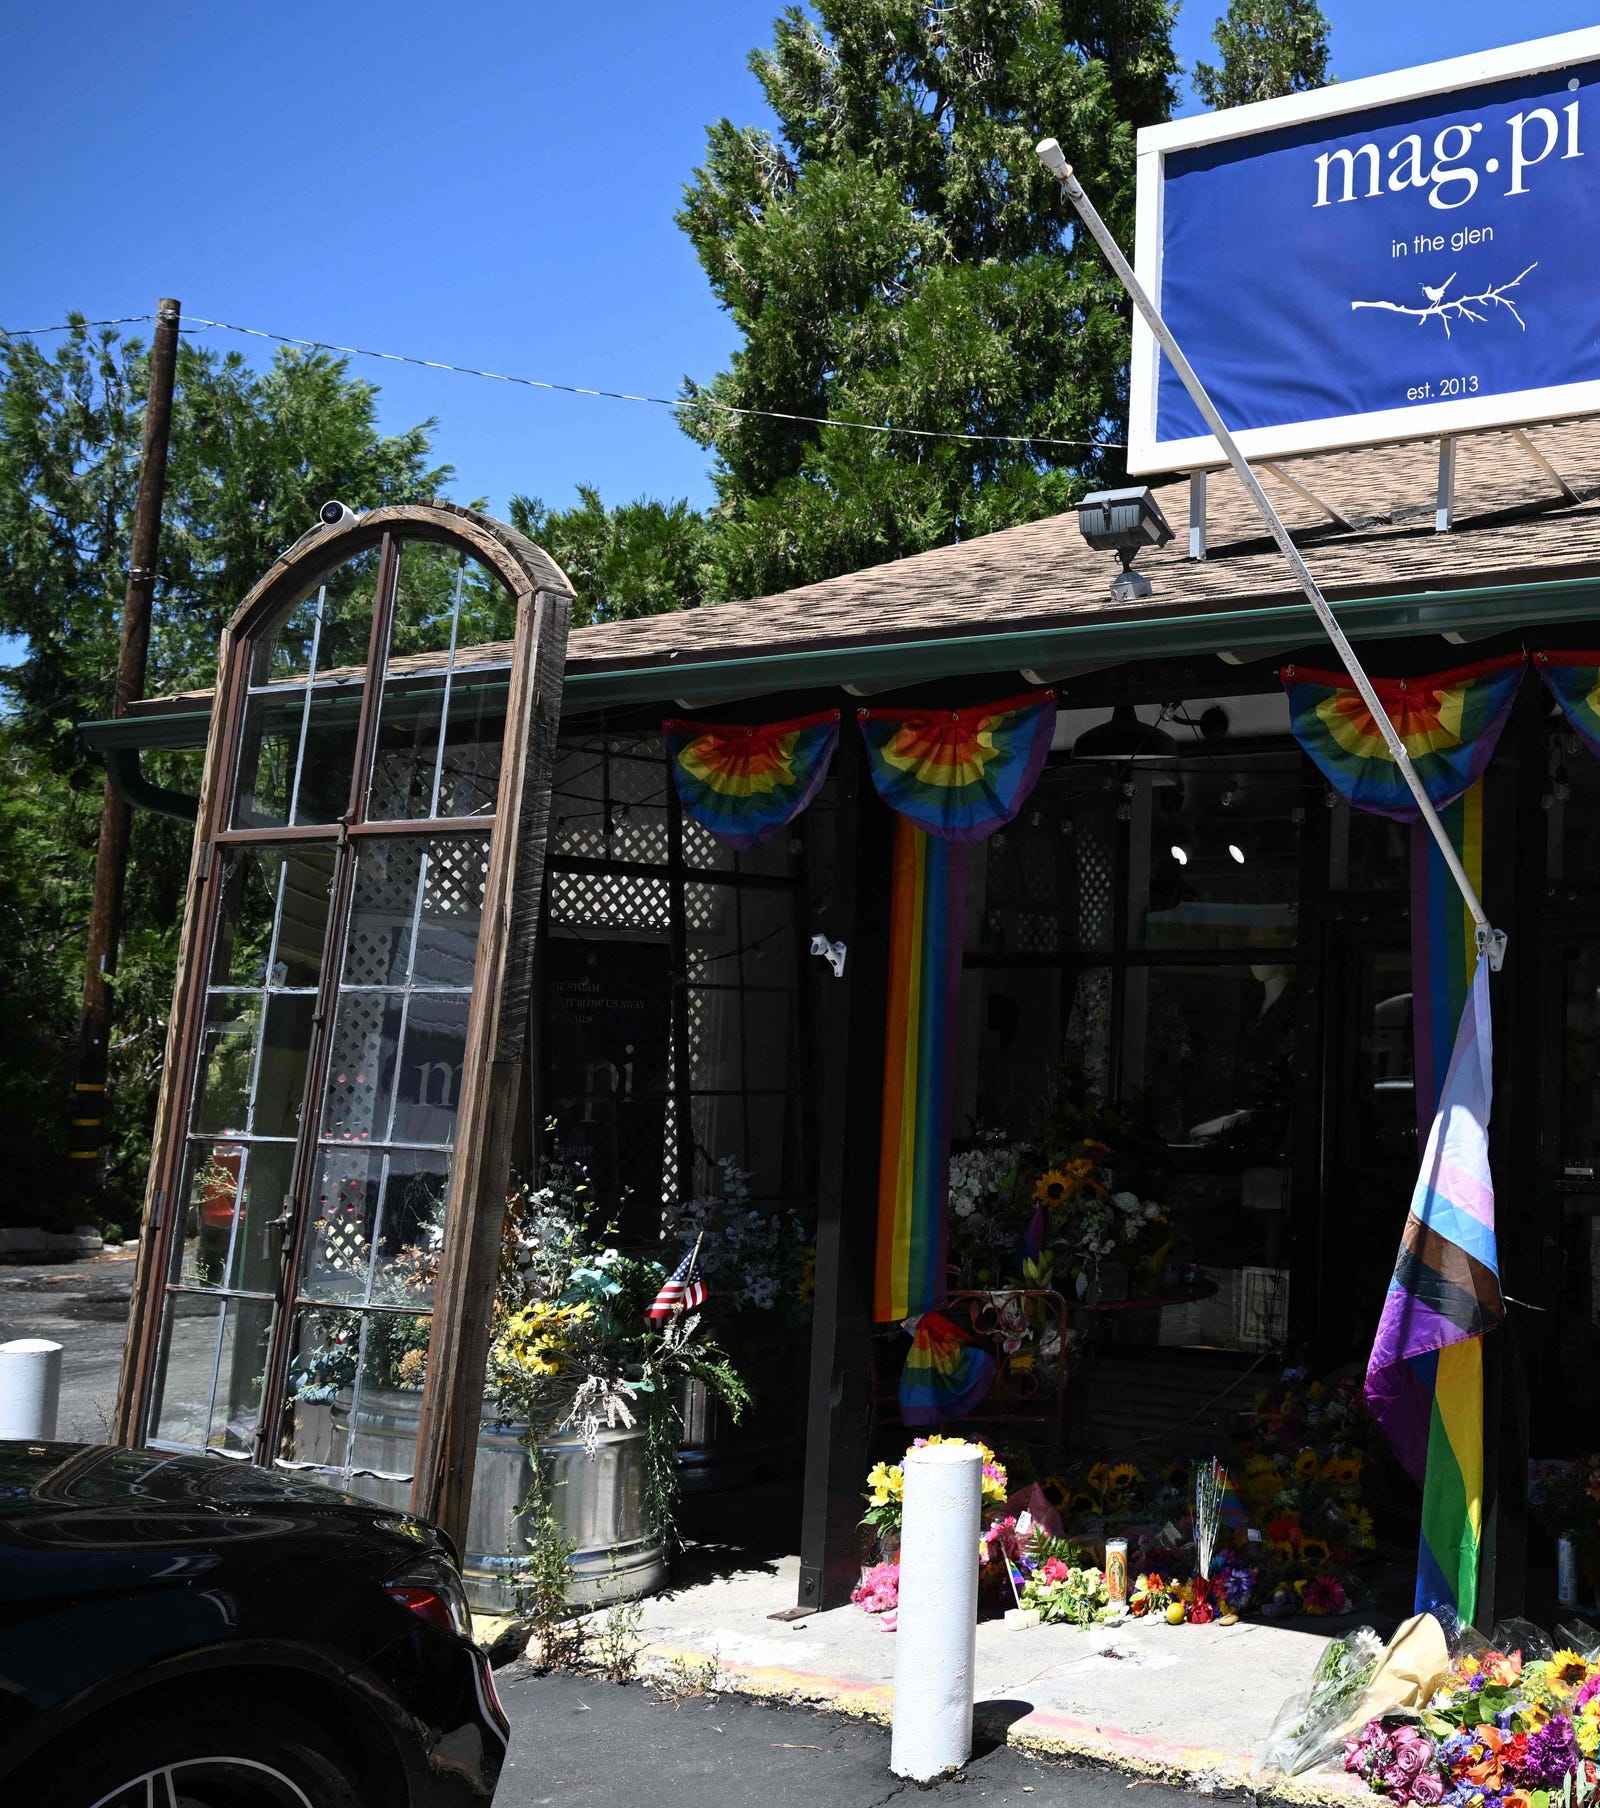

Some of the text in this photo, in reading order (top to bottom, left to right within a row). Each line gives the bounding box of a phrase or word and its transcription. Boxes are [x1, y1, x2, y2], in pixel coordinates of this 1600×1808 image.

[1312, 78, 1584, 210] mag.pi
[1391, 226, 1494, 258] in the glen
[1406, 375, 1479, 401] est. 2013
